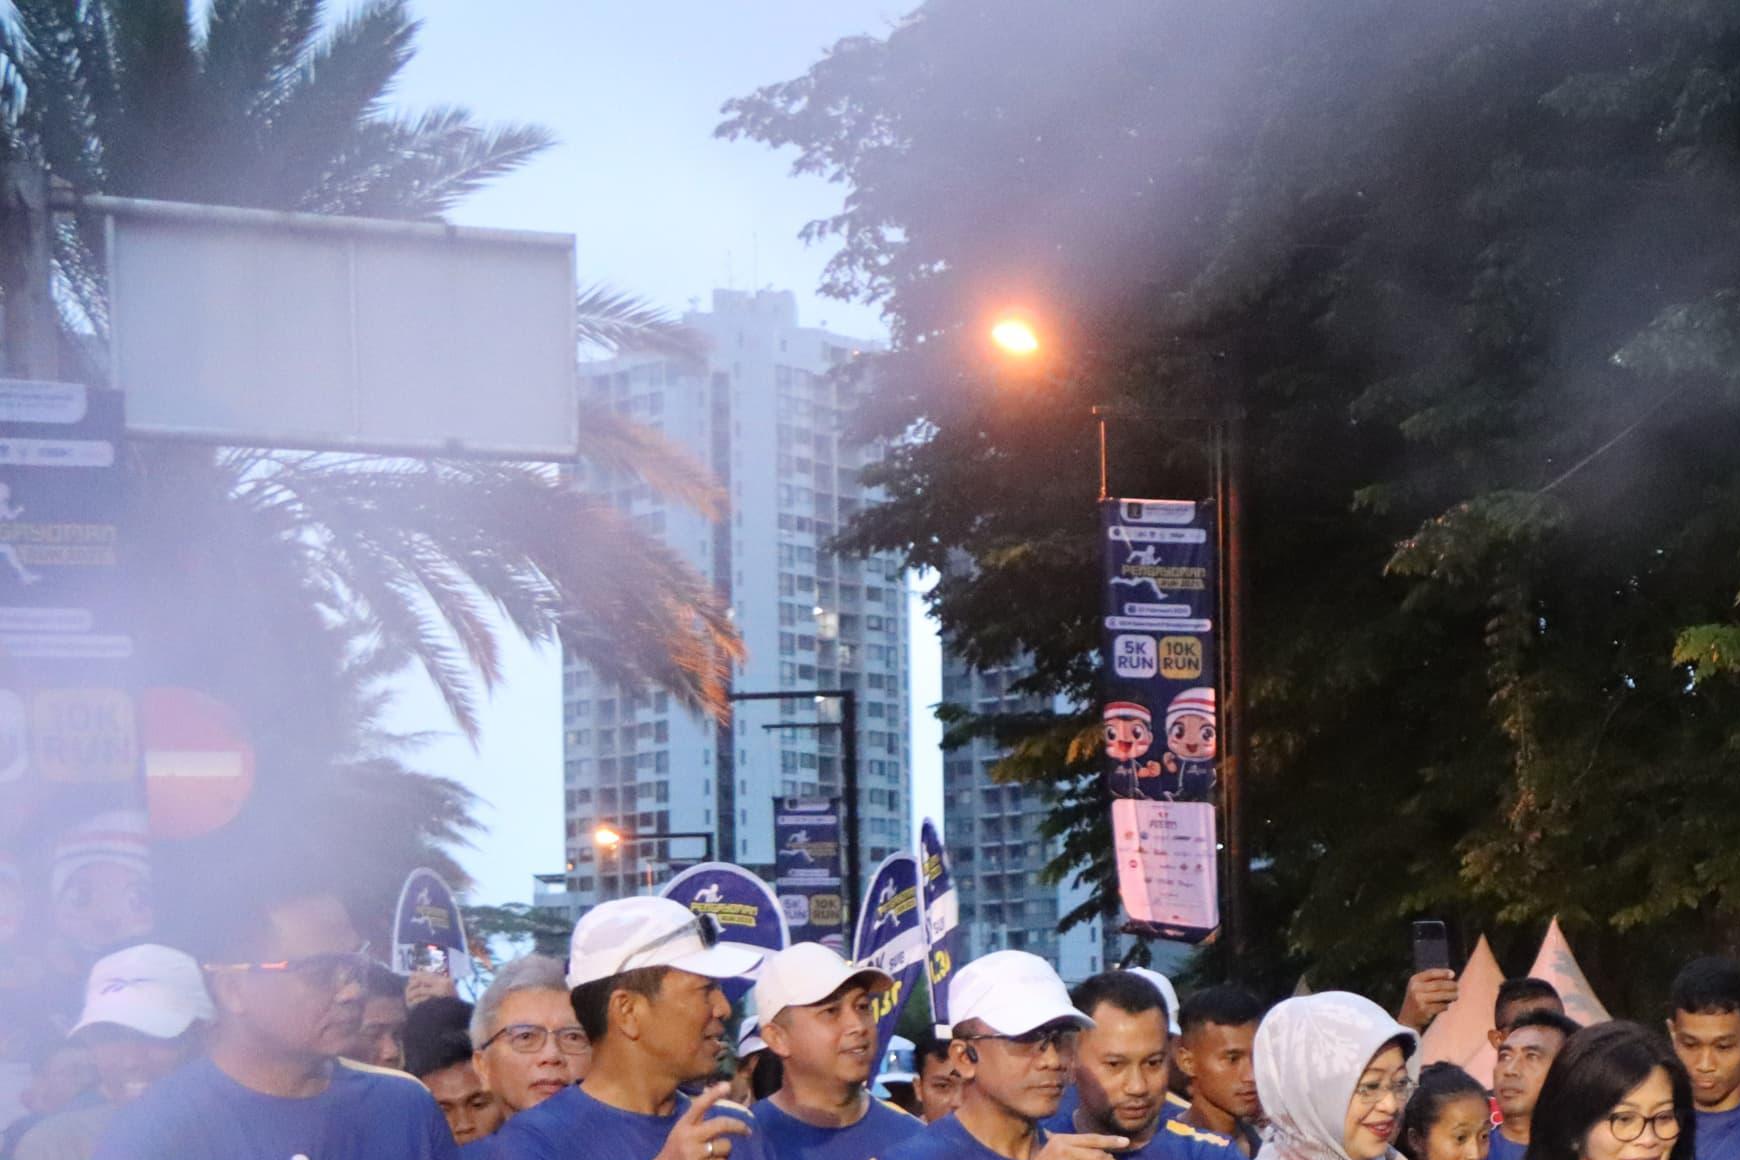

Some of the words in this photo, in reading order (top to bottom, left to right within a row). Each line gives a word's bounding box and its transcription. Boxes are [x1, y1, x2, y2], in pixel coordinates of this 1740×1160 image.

[1124, 641, 1147, 655] 5K
[1166, 642, 1196, 657] 10K
[1118, 656, 1154, 670] RUN
[1163, 657, 1200, 671] RUN
